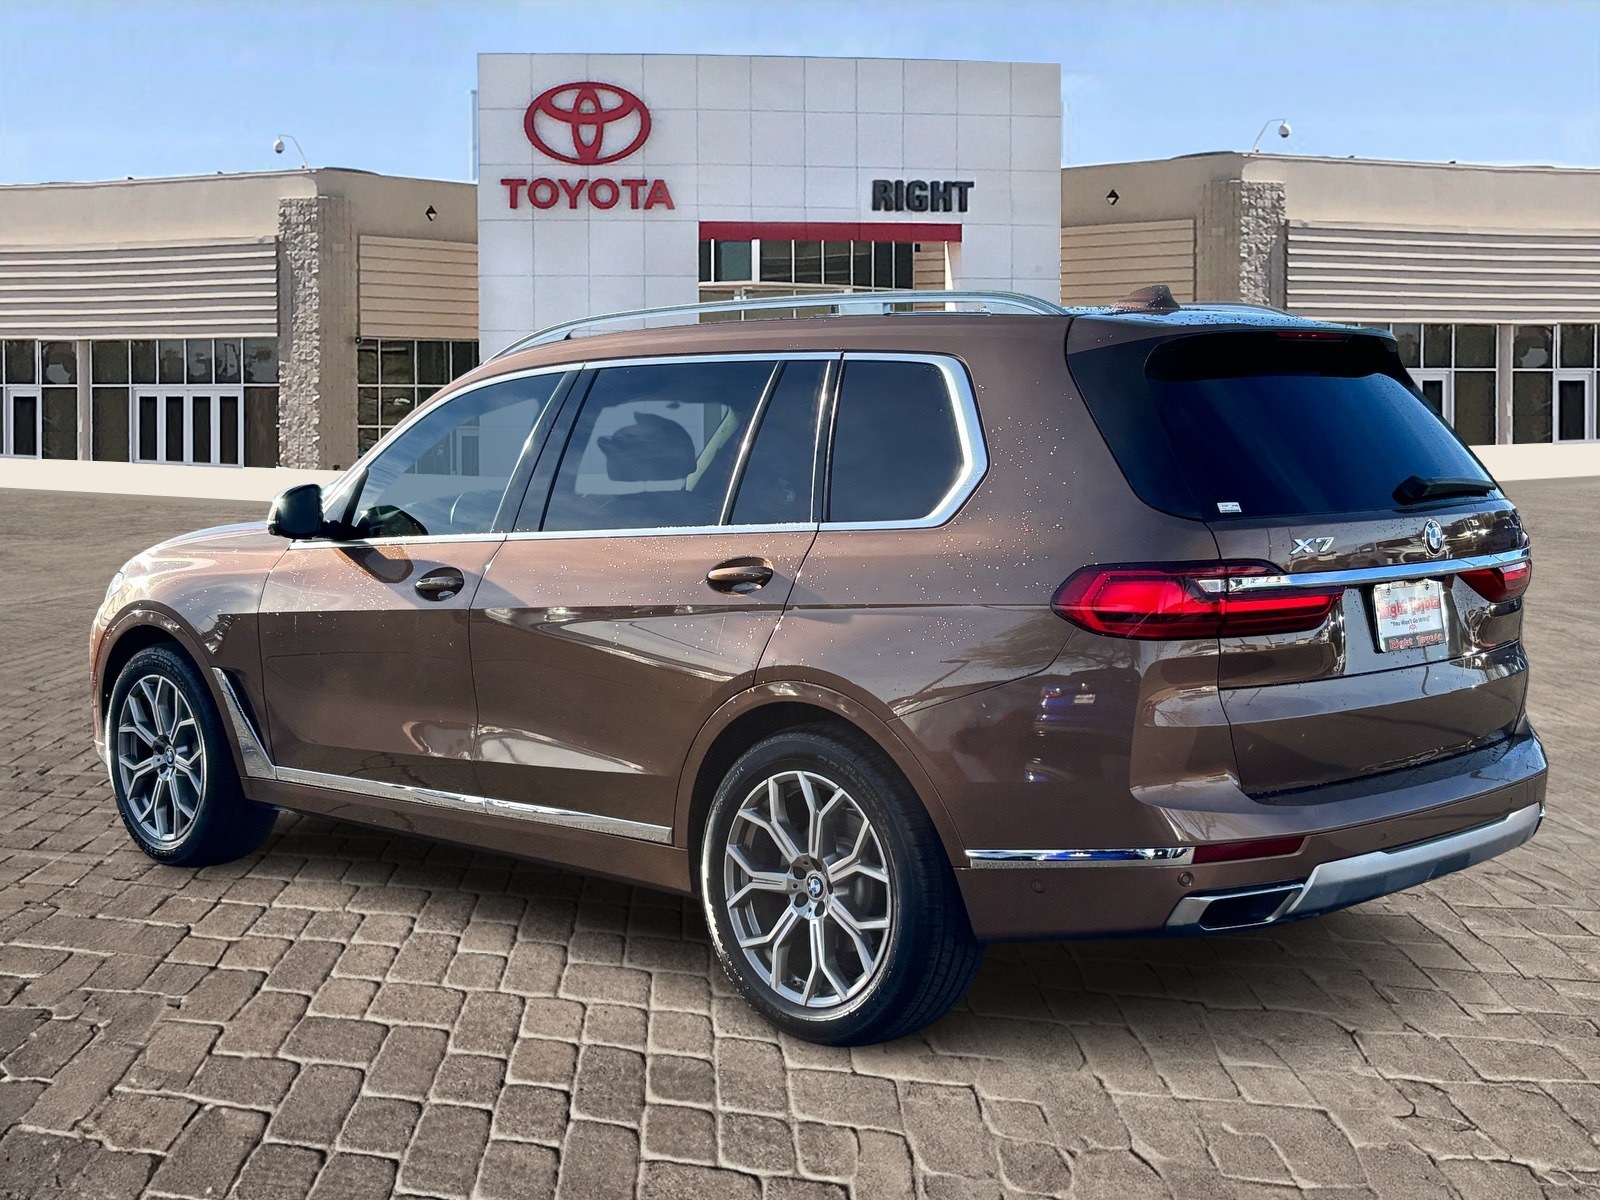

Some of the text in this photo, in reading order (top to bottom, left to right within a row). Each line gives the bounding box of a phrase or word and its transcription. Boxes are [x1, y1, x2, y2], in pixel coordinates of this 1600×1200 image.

[500, 178, 675, 211] TOYOTA
[871, 179, 975, 212] RIGHT
[1289, 536, 1335, 555] X7
